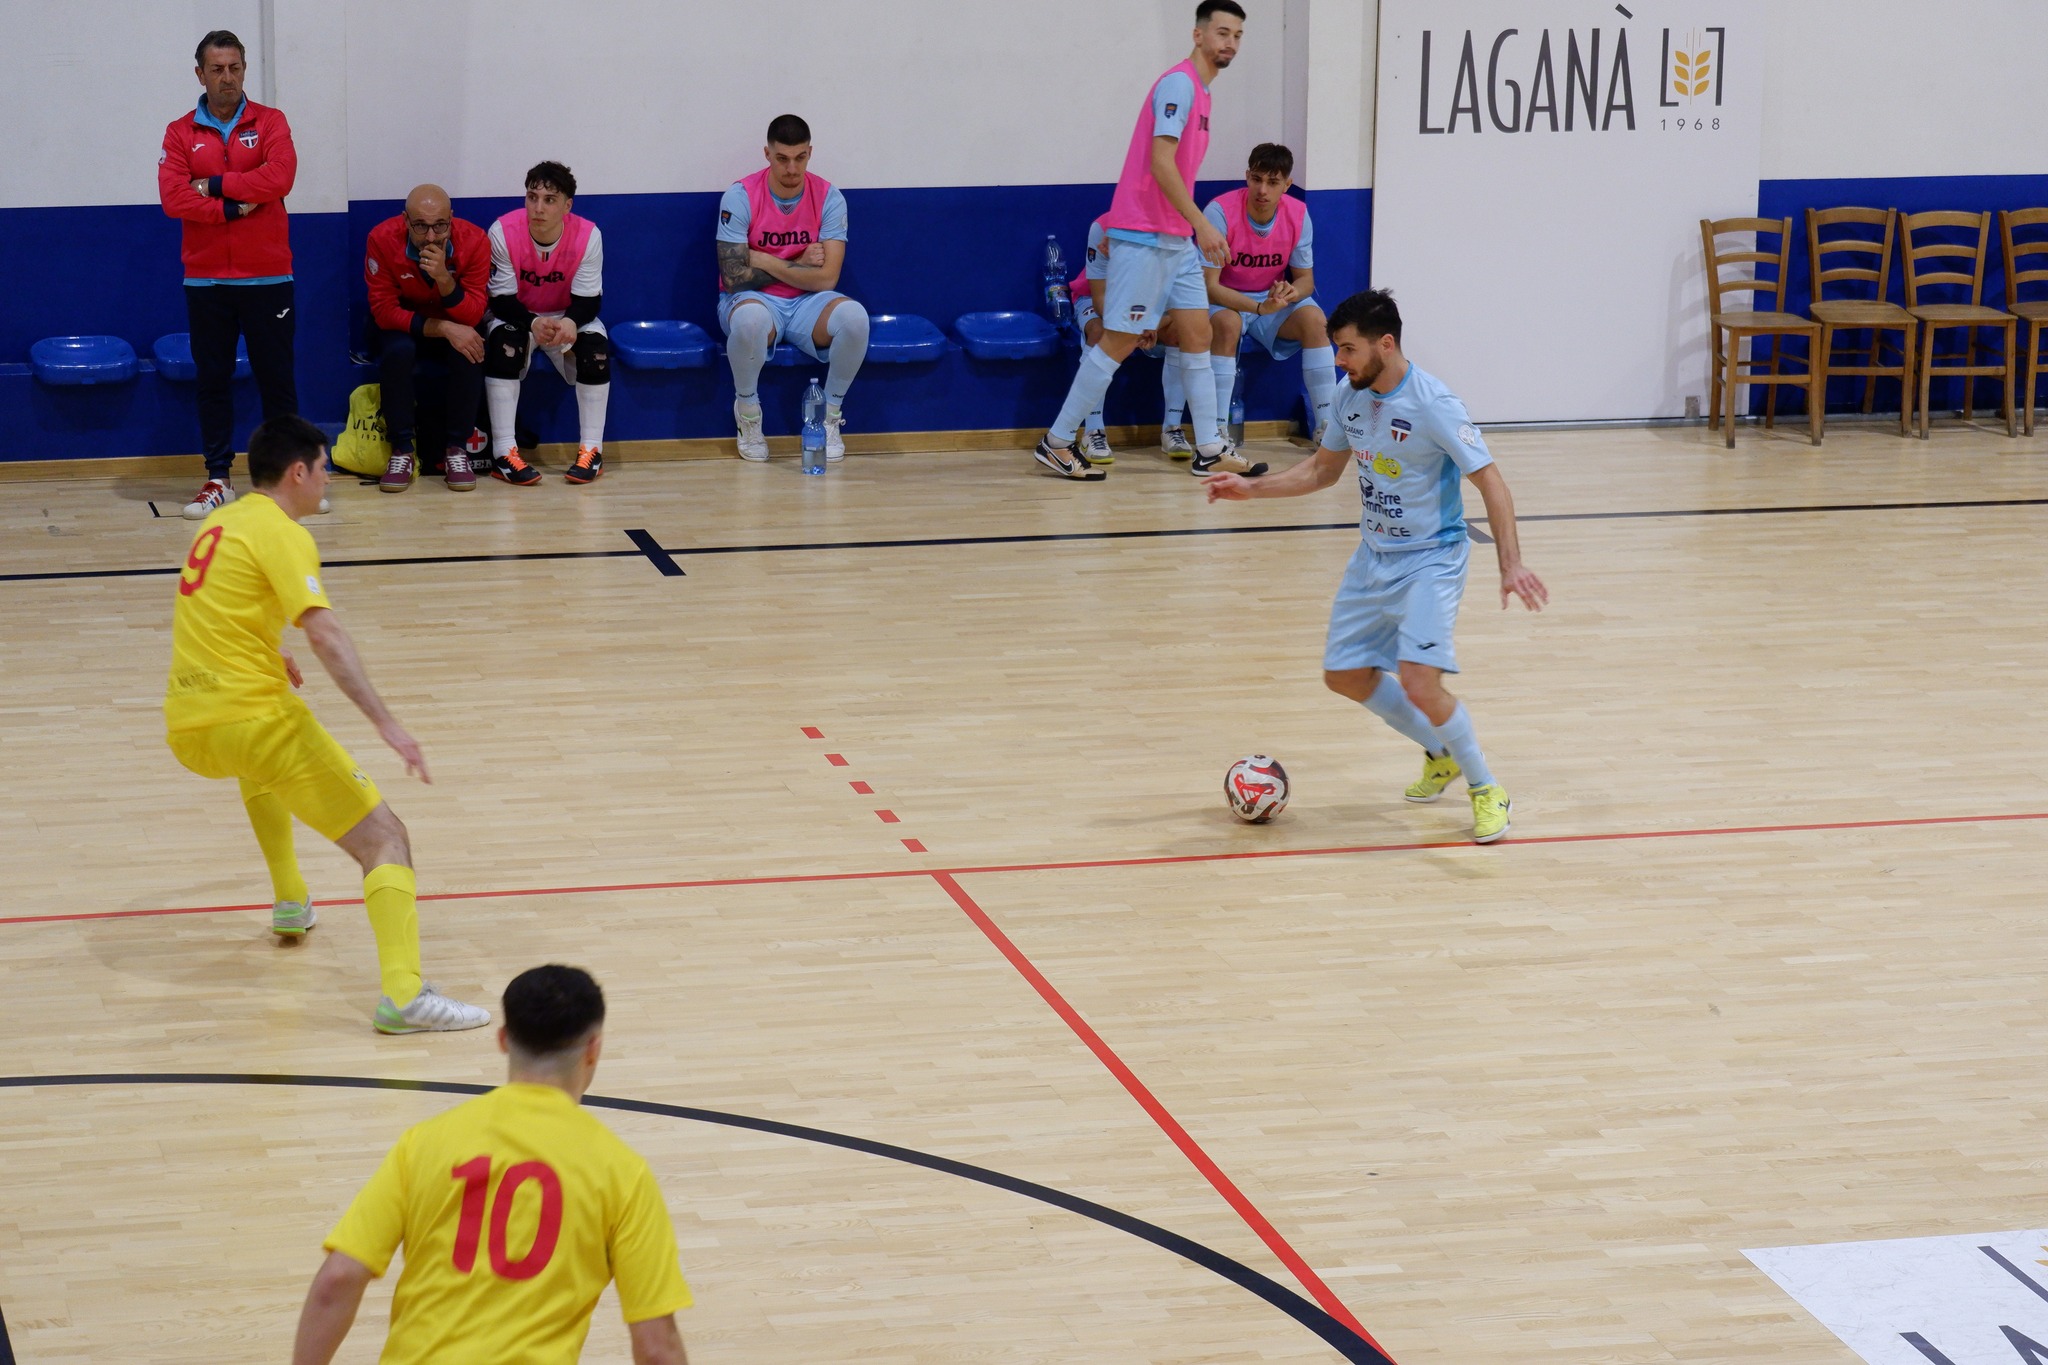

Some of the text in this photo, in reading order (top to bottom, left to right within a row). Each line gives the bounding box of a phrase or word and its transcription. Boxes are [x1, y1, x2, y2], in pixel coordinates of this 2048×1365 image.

[1419, 3, 1636, 134] LAGANÀ
[1660, 117, 1720, 131] 1968
[179, 525, 223, 597] 9
[451, 1155, 563, 1282] 10
